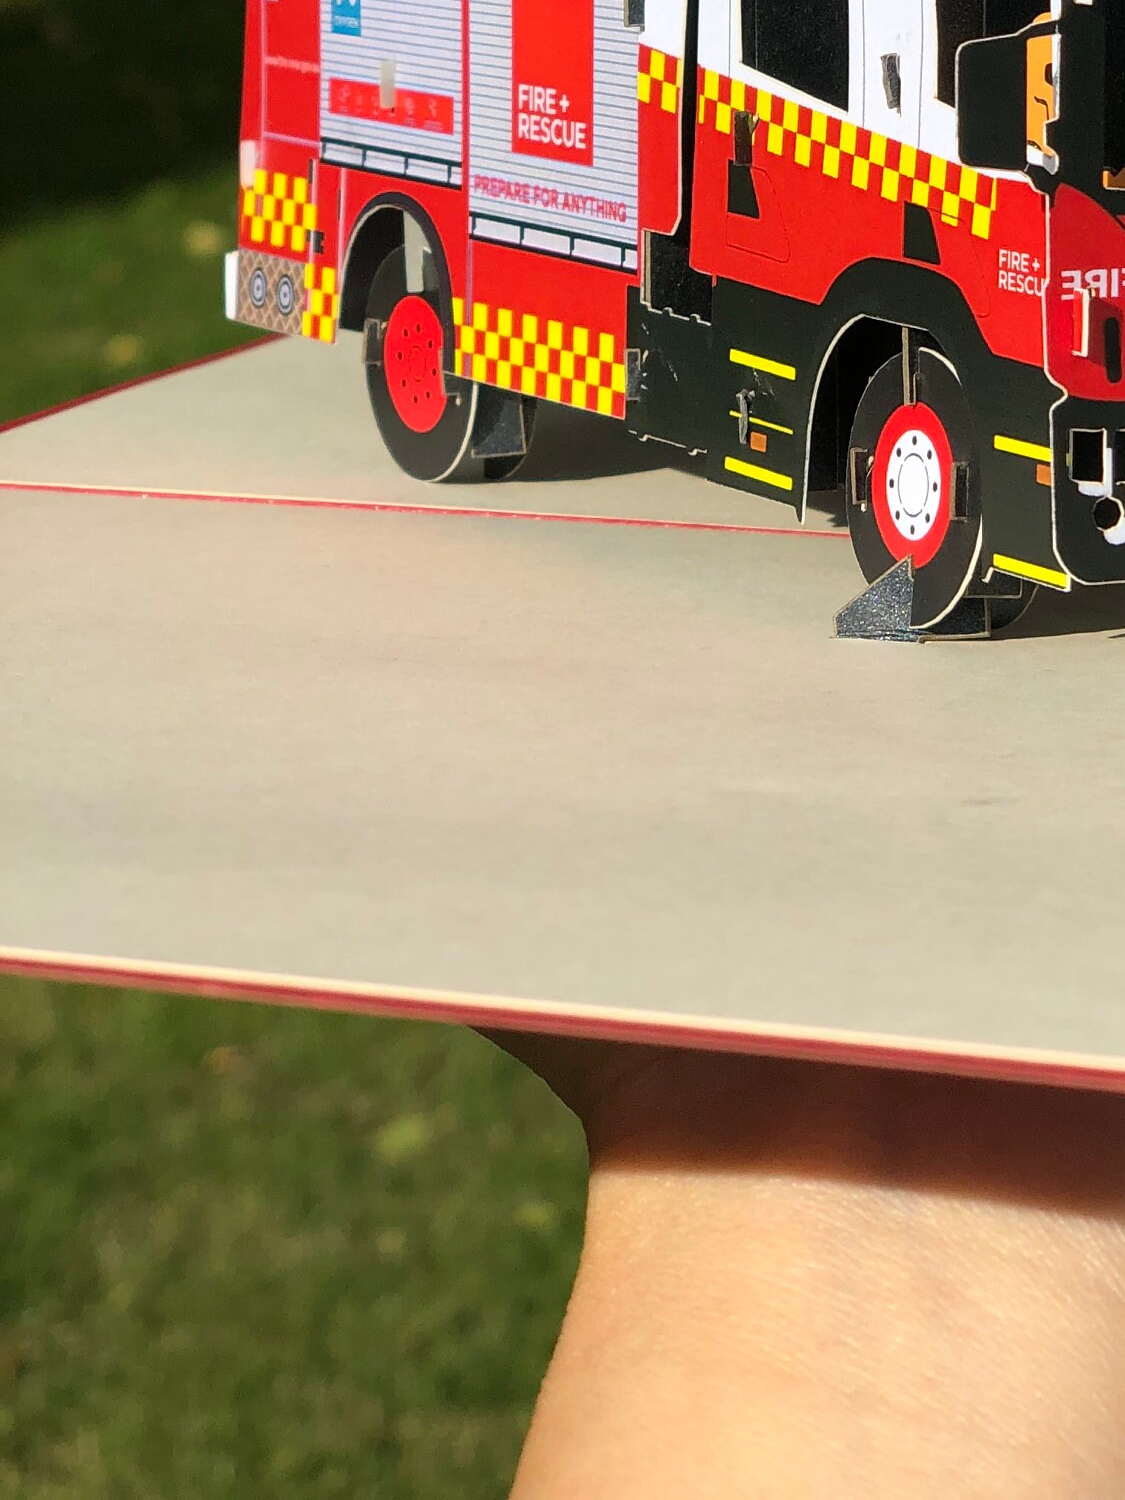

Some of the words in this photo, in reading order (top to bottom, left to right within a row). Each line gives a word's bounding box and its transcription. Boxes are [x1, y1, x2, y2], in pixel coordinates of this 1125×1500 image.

[518, 83, 557, 115] FIRE
[518, 112, 586, 150] RESCUE
[474, 174, 530, 204] PREPARE
[534, 184, 558, 209] FOR
[562, 190, 627, 223] ANYTHING
[999, 248, 1030, 273] FIRE
